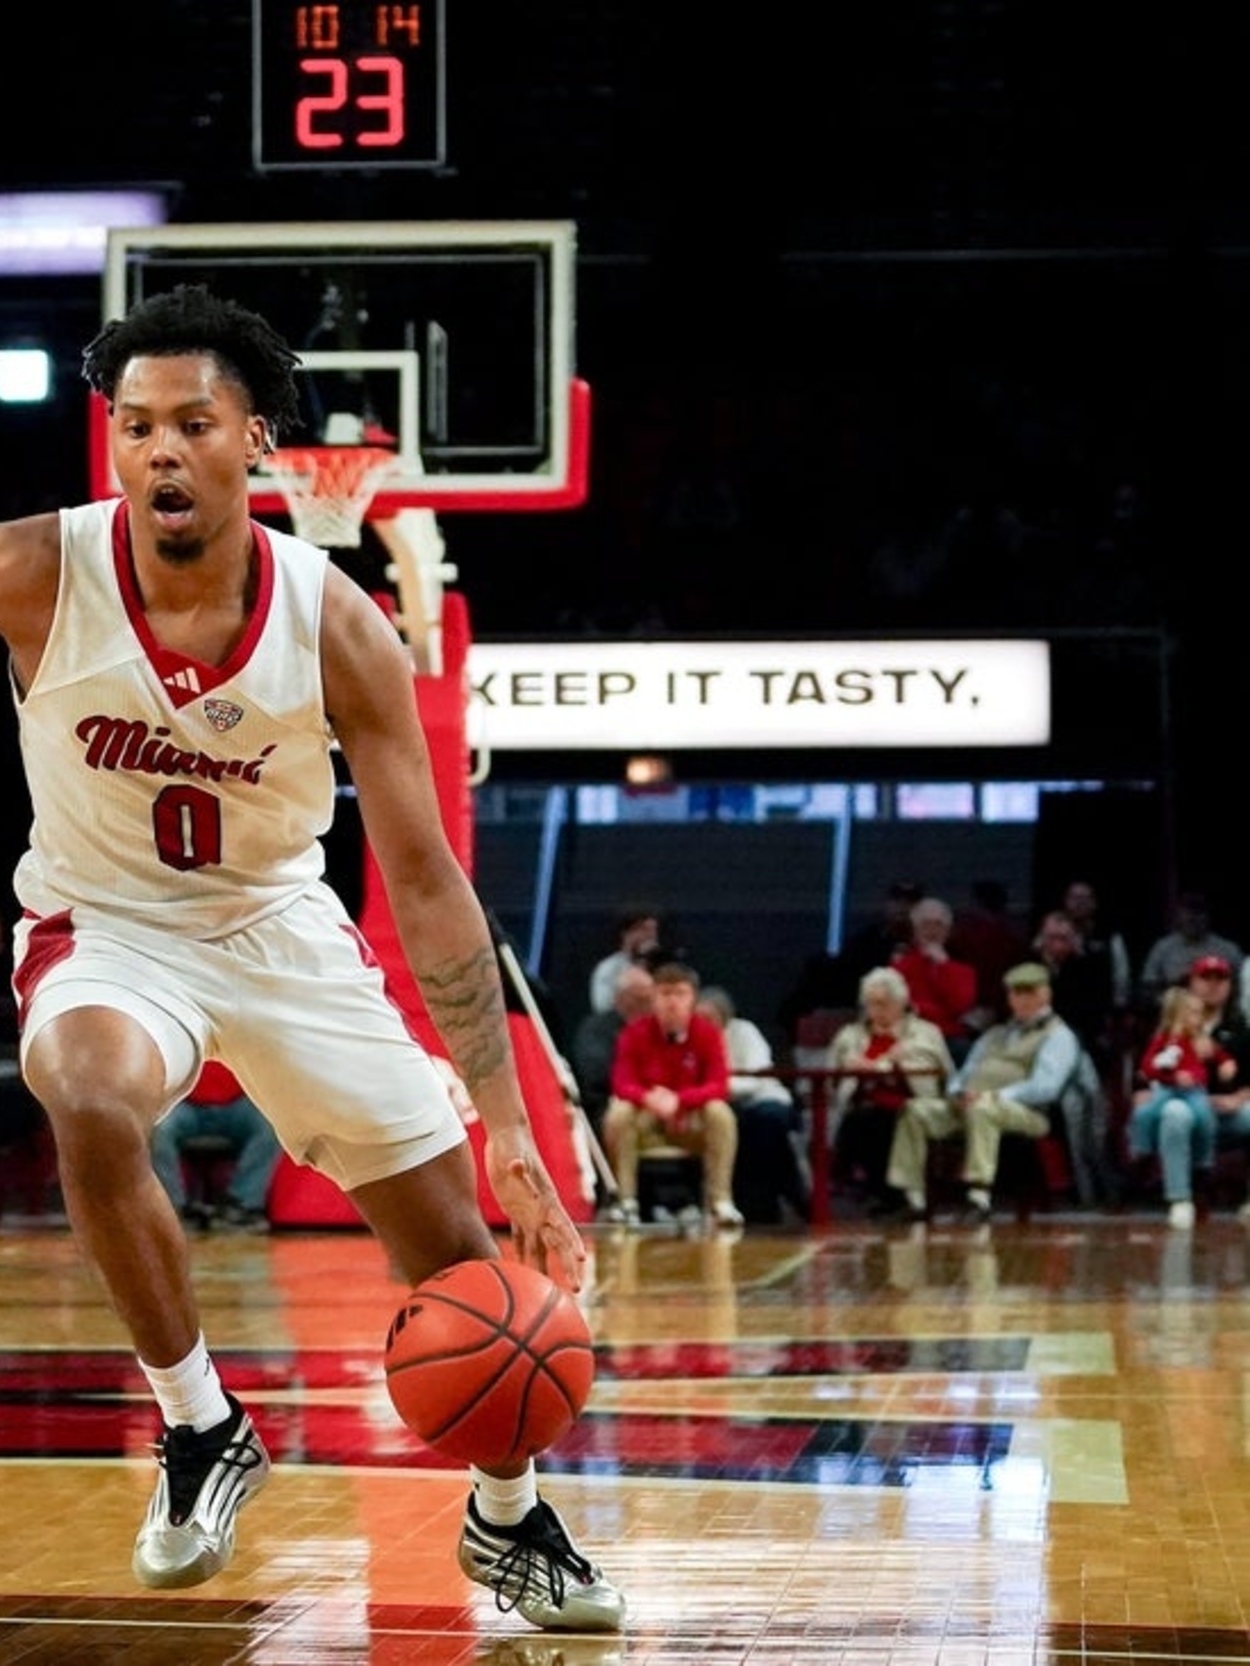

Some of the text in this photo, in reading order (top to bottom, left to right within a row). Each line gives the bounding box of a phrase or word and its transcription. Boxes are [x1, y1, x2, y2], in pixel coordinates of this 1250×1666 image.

[297, 5, 420, 49] 10 14
[296, 56, 404, 147] 23
[470, 668, 982, 708] KEEP IT TASTY,
[75, 715, 278, 785] Miami
[152, 784, 222, 872] 0
